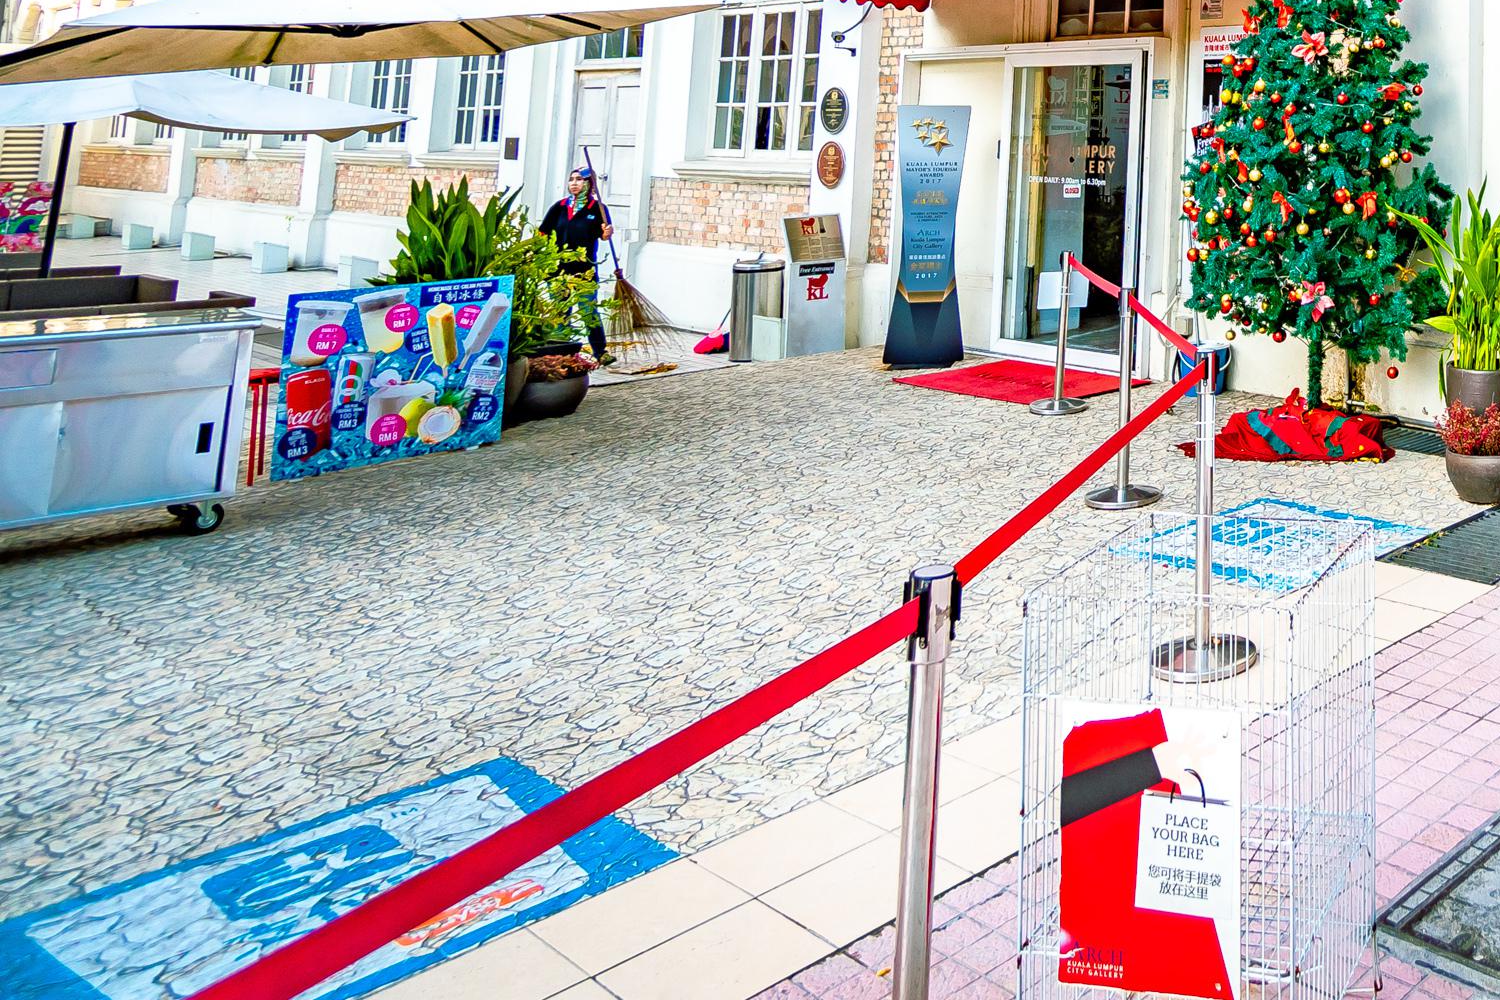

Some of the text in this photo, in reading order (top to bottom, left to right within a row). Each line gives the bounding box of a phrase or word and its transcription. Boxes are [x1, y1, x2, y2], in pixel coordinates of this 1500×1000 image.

[1204, 34, 1226, 43] KUALA
[1028, 175, 1043, 183] OPEN
[1044, 176, 1060, 184] DAILY:
[1086, 178, 1106, 187] 6.30pm
[916, 228, 940, 236] ARCH
[812, 265, 834, 273] Entrance
[1165, 813, 1209, 831] PLACE
[1152, 826, 1220, 847] YOUR BAG
[1167, 844, 1204, 861] HERE
[1148, 864, 1222, 888] 您可将手提袋
[1159, 881, 1209, 900] 放在这里
[1067, 959, 1124, 972] KUALA LUMPUR
[1066, 966, 1124, 979] CITY GALLERY
